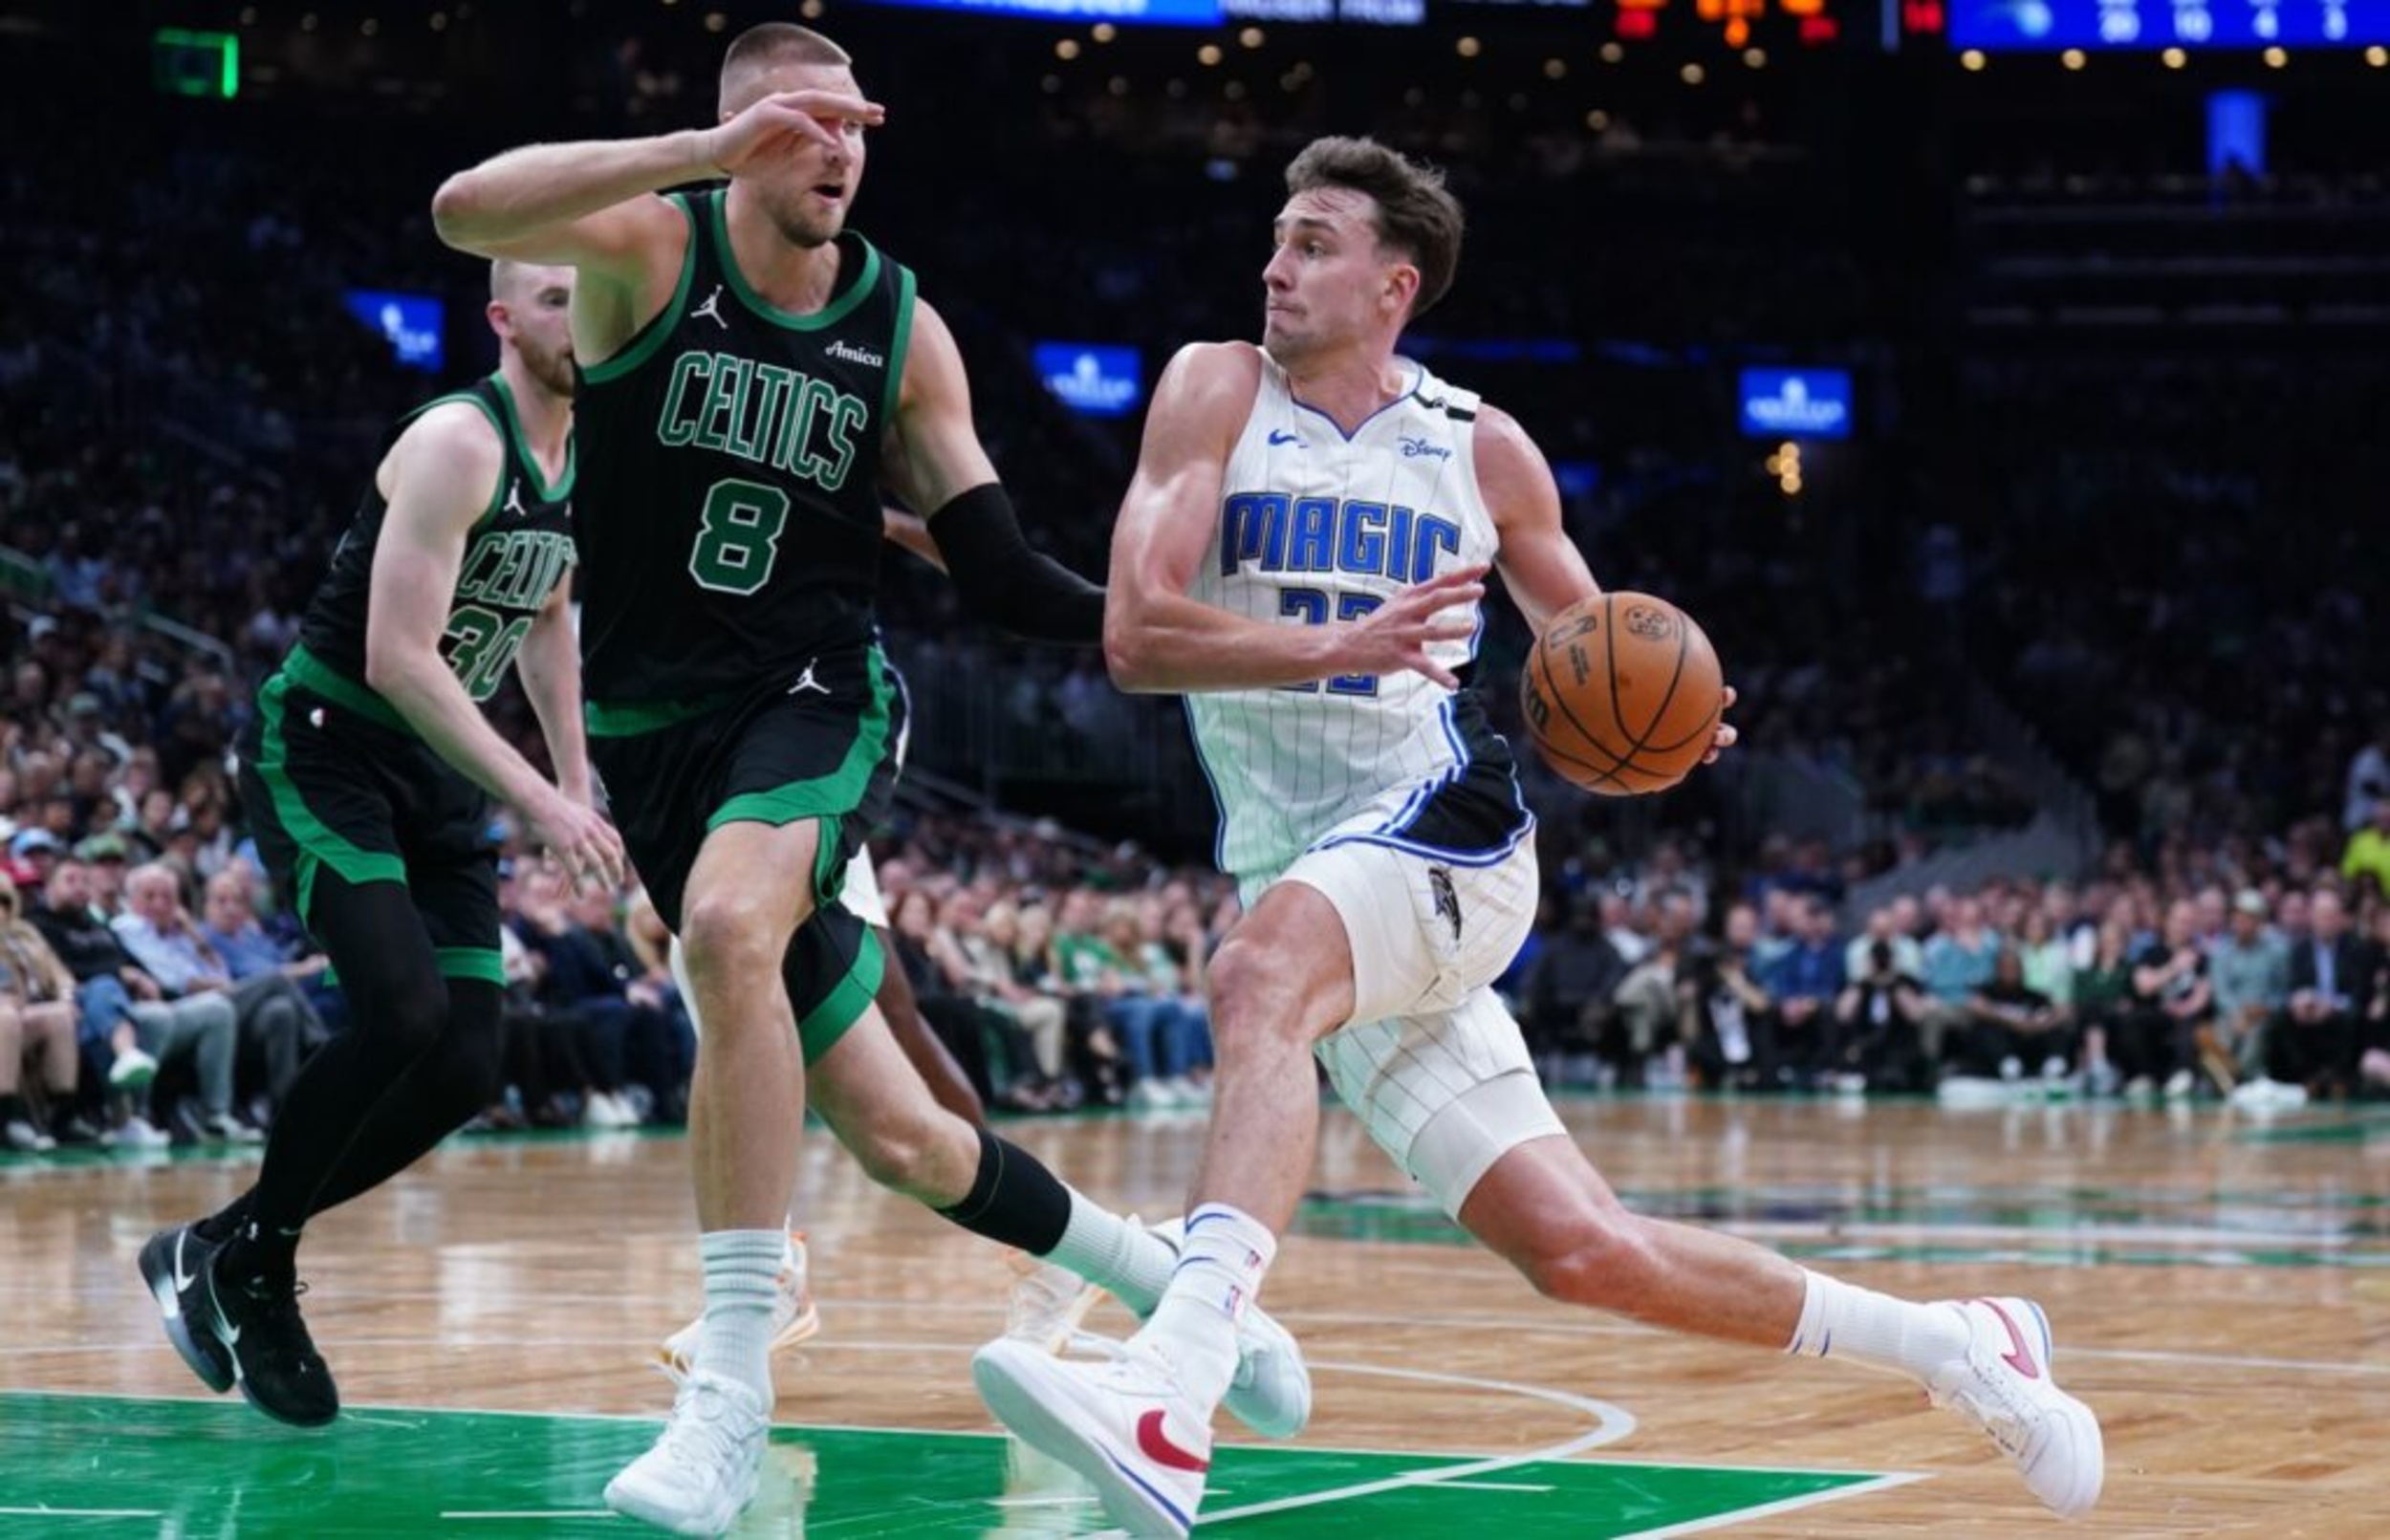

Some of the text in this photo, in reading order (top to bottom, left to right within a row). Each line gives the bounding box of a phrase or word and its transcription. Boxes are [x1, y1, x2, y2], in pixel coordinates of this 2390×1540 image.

[825, 339, 883, 368] Amica
[658, 350, 869, 491] CELTICS
[1397, 436, 1452, 463] Disney
[688, 478, 791, 596] 8
[1221, 490, 1462, 586] MAGIC
[446, 604, 533, 702] 30
